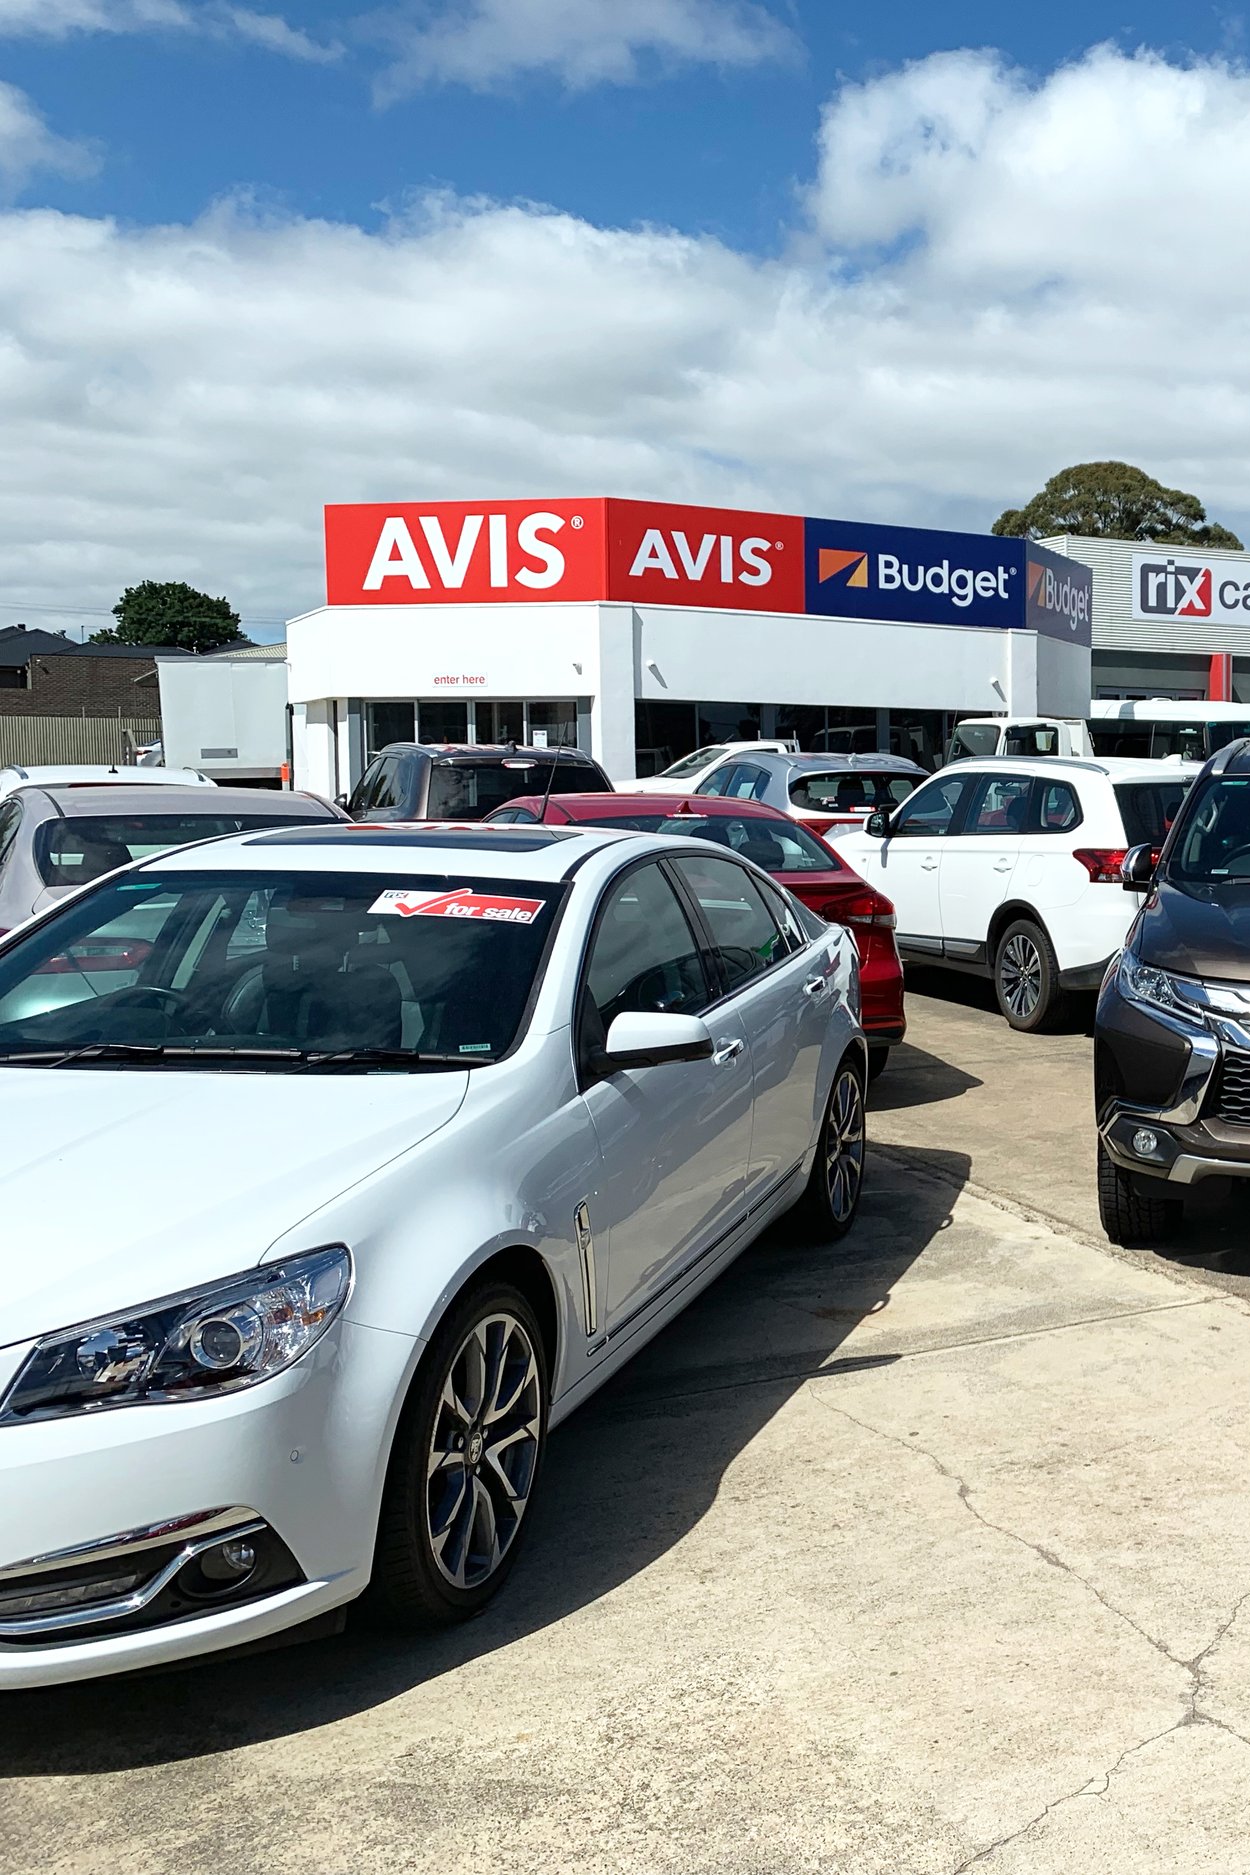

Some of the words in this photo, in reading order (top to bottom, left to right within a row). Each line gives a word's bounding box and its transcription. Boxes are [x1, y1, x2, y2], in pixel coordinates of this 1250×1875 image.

[362, 512, 566, 590] AVIS
[629, 529, 772, 586] AVIS
[878, 553, 1009, 607] Budget
[1046, 568, 1089, 631] Budget
[1148, 559, 1207, 610] rix
[434, 675, 460, 684] enter
[462, 674, 485, 684] here
[444, 902, 480, 916] for
[482, 906, 532, 921] sale
